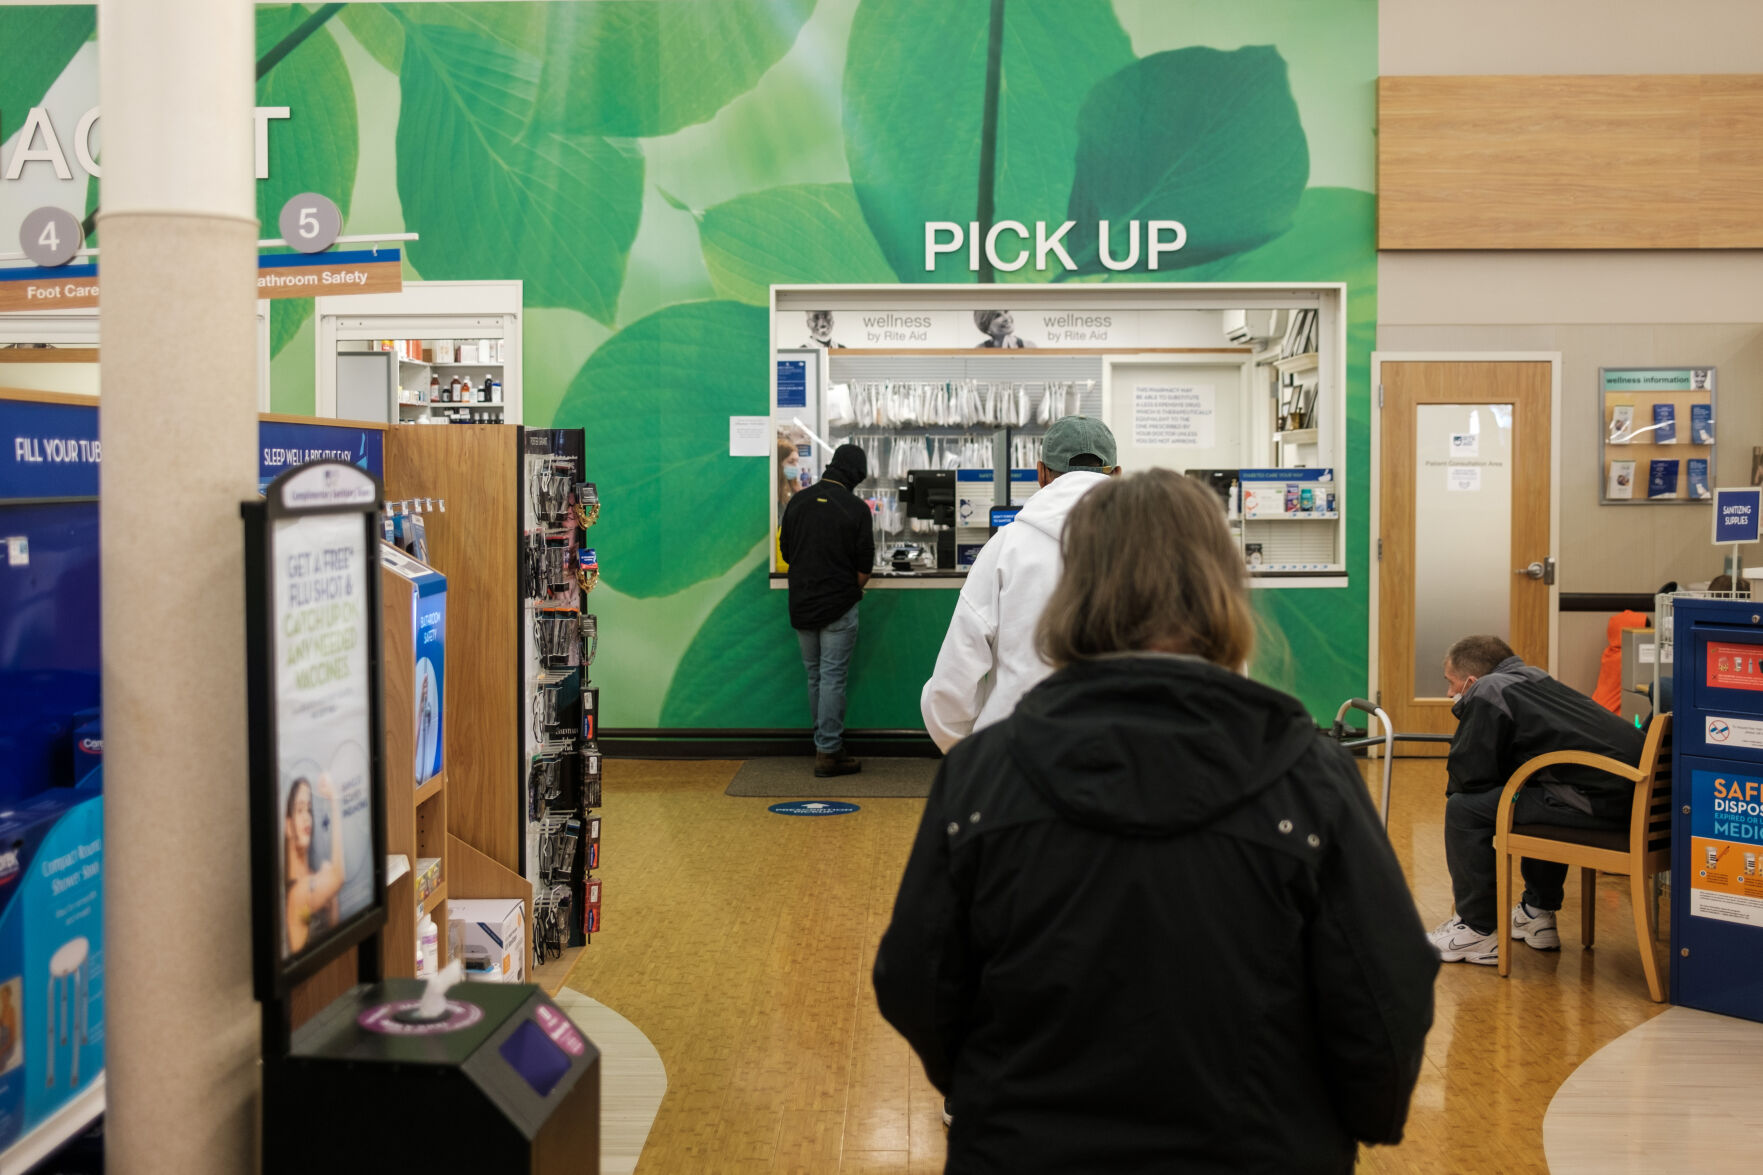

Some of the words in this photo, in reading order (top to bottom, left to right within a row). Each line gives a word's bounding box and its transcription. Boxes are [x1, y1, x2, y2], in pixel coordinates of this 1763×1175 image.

[299, 208, 320, 239] 5
[37, 221, 60, 251] 4
[925, 220, 1078, 272] PICK
[1098, 220, 1187, 271] UP
[256, 275, 318, 288] athroom
[321, 271, 368, 285] Safety
[27, 286, 61, 300] Foot
[64, 284, 99, 298] Care
[863, 313, 932, 329] wellness
[1043, 312, 1112, 328] wellness
[867, 331, 880, 344] by
[884, 330, 906, 341] Rite
[909, 330, 927, 341] Aid
[1047, 330, 1060, 343] by
[1064, 330, 1087, 341] Rite
[1089, 330, 1108, 341] Aid
[1606, 375, 1641, 384] wellness
[1643, 374, 1690, 383] information
[15, 437, 43, 462] FILL
[43, 438, 78, 463] YOUR
[79, 440, 101, 463] TUB
[264, 448, 285, 465] SLEEP
[286, 449, 304, 465] WELL
[305, 449, 310, 462] &
[1723, 505, 1751, 514] SANITIZING
[1725, 516, 1748, 525] SUPPLIES
[288, 552, 310, 578] GET
[314, 575, 343, 602] SHOT
[1714, 778, 1763, 803] SAF
[1714, 812, 1746, 823] EXPIRED
